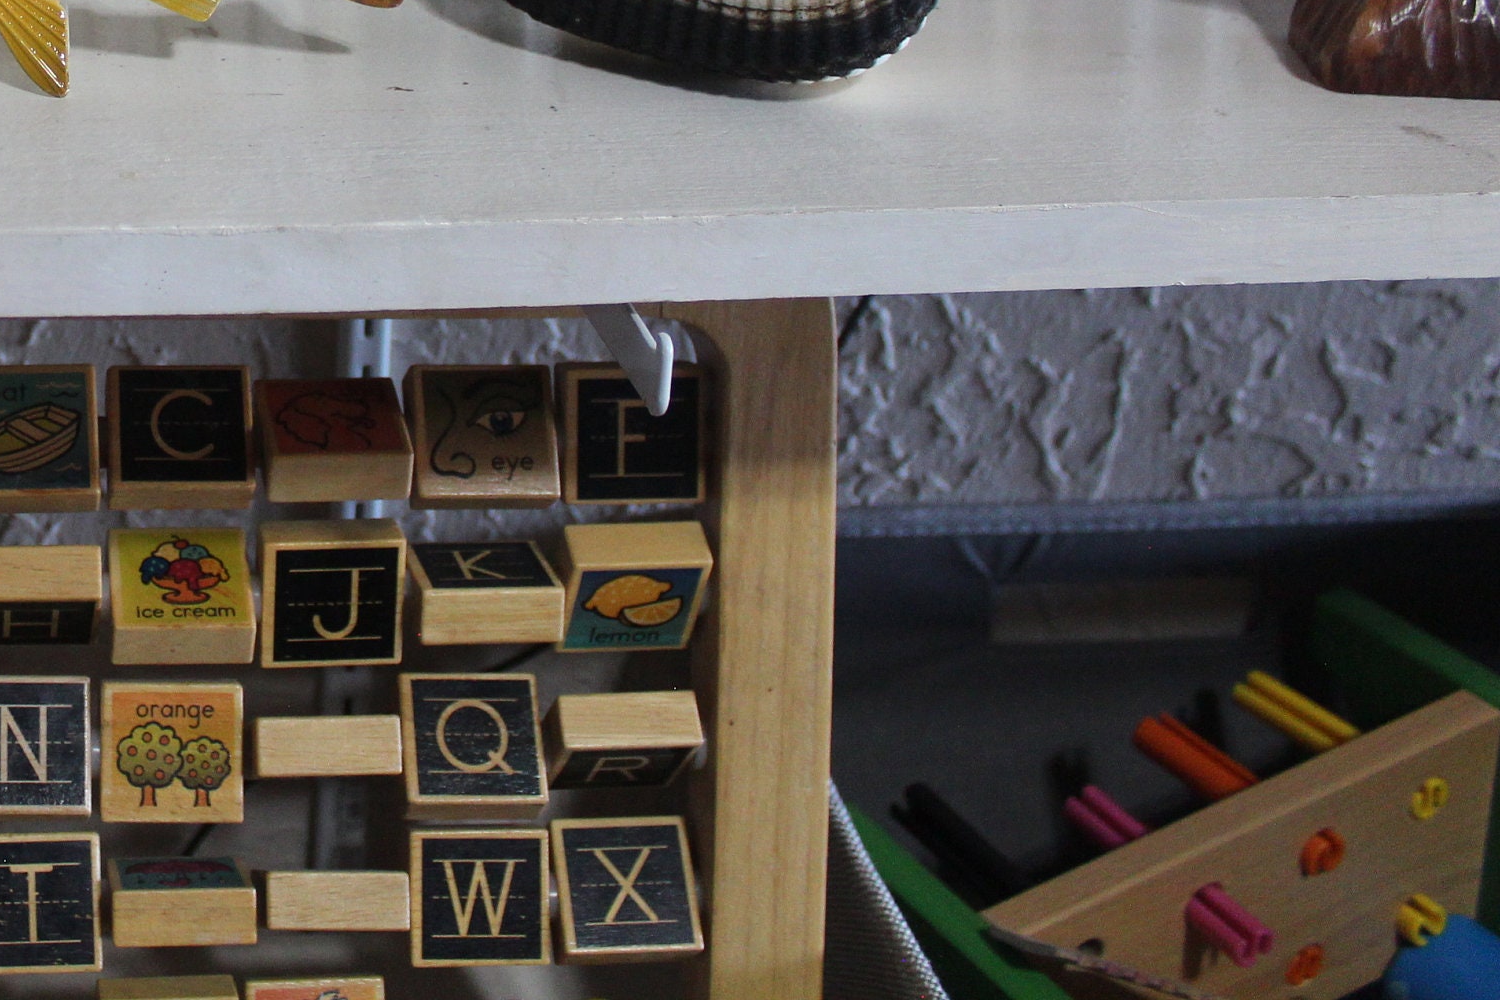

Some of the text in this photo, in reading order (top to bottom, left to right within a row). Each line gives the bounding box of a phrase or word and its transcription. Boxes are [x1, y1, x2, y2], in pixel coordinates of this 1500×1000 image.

[149, 388, 215, 461] C
[490, 453, 534, 481] eye
[452, 550, 507, 580] K
[2, 608, 60, 638] H
[136, 604, 237, 619] ice cream
[312, 567, 360, 641] J
[588, 626, 661, 645] lemon
[135, 701, 215, 729] orange
[435, 698, 518, 776] Q
[0, 704, 49, 783] N
[586, 756, 651, 782] R
[9, 862, 55, 943] T
[443, 859, 516, 937] W
[592, 847, 659, 924] X
